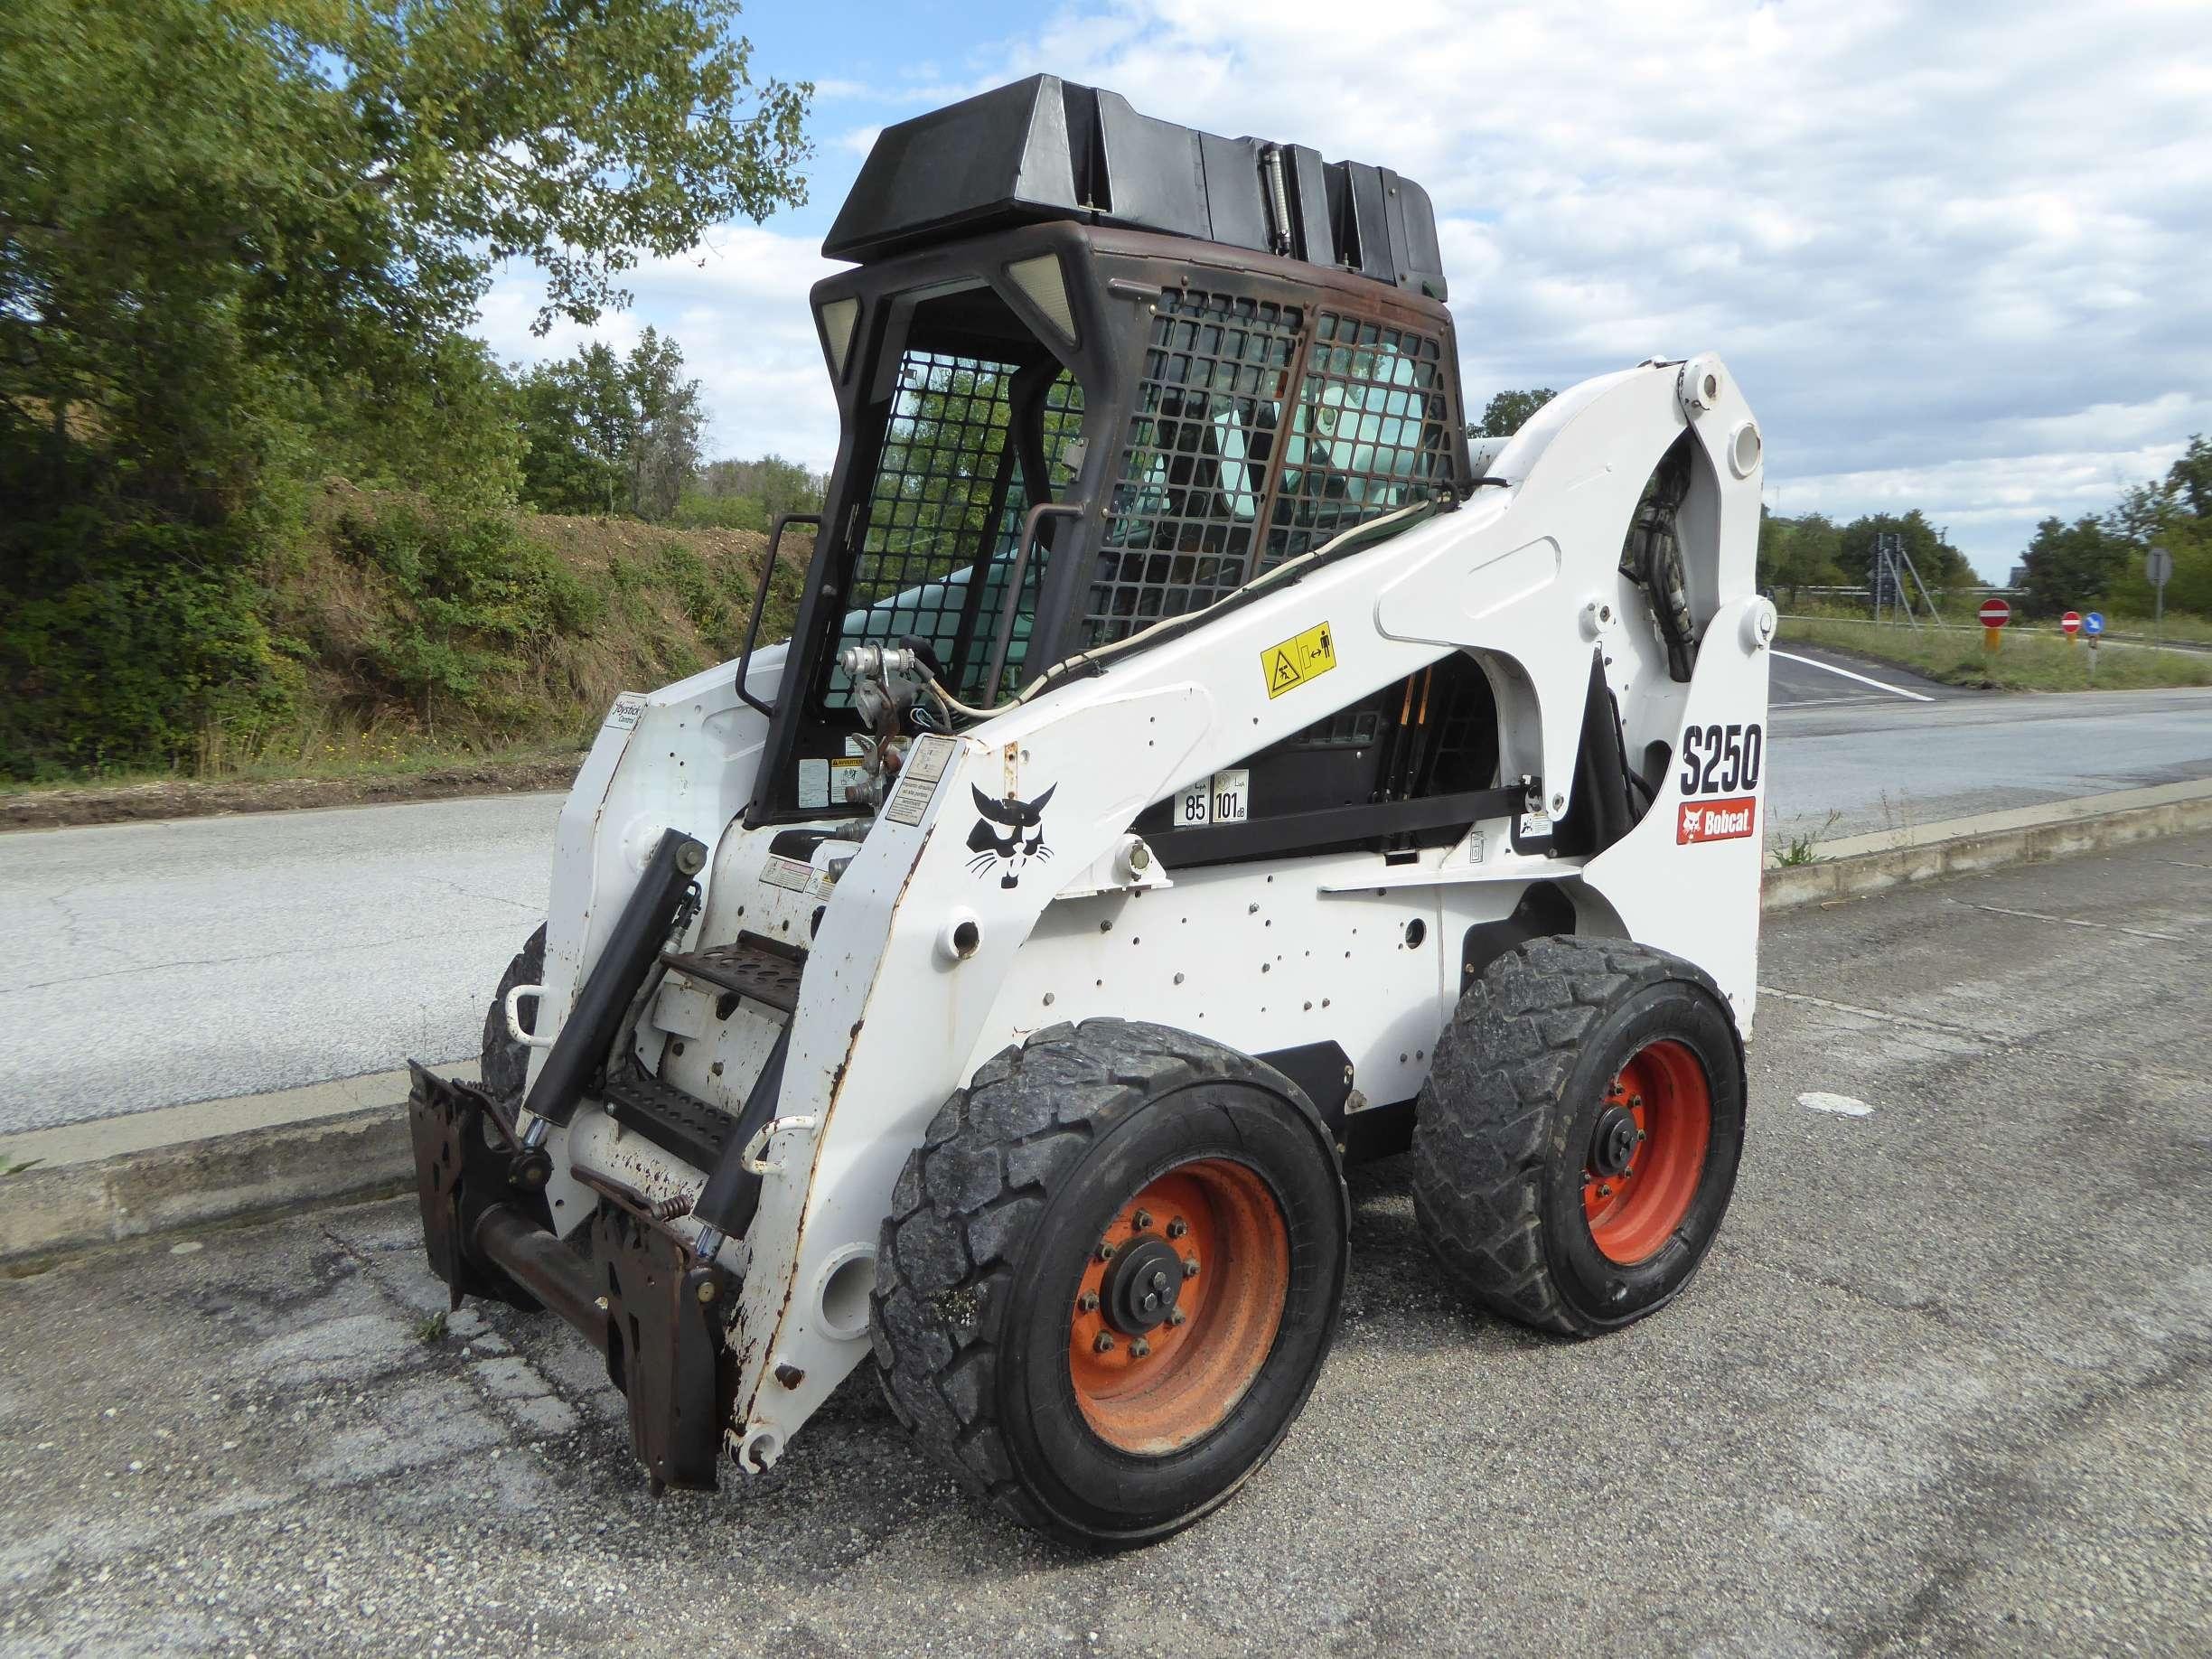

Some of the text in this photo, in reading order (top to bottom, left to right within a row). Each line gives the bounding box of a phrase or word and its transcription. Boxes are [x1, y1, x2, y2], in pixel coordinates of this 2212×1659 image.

[1681, 724, 1762, 795] S250
[1186, 794, 1205, 820] 85
[1215, 792, 1245, 819] 101 dB
[1704, 808, 1749, 836] Bobcat
